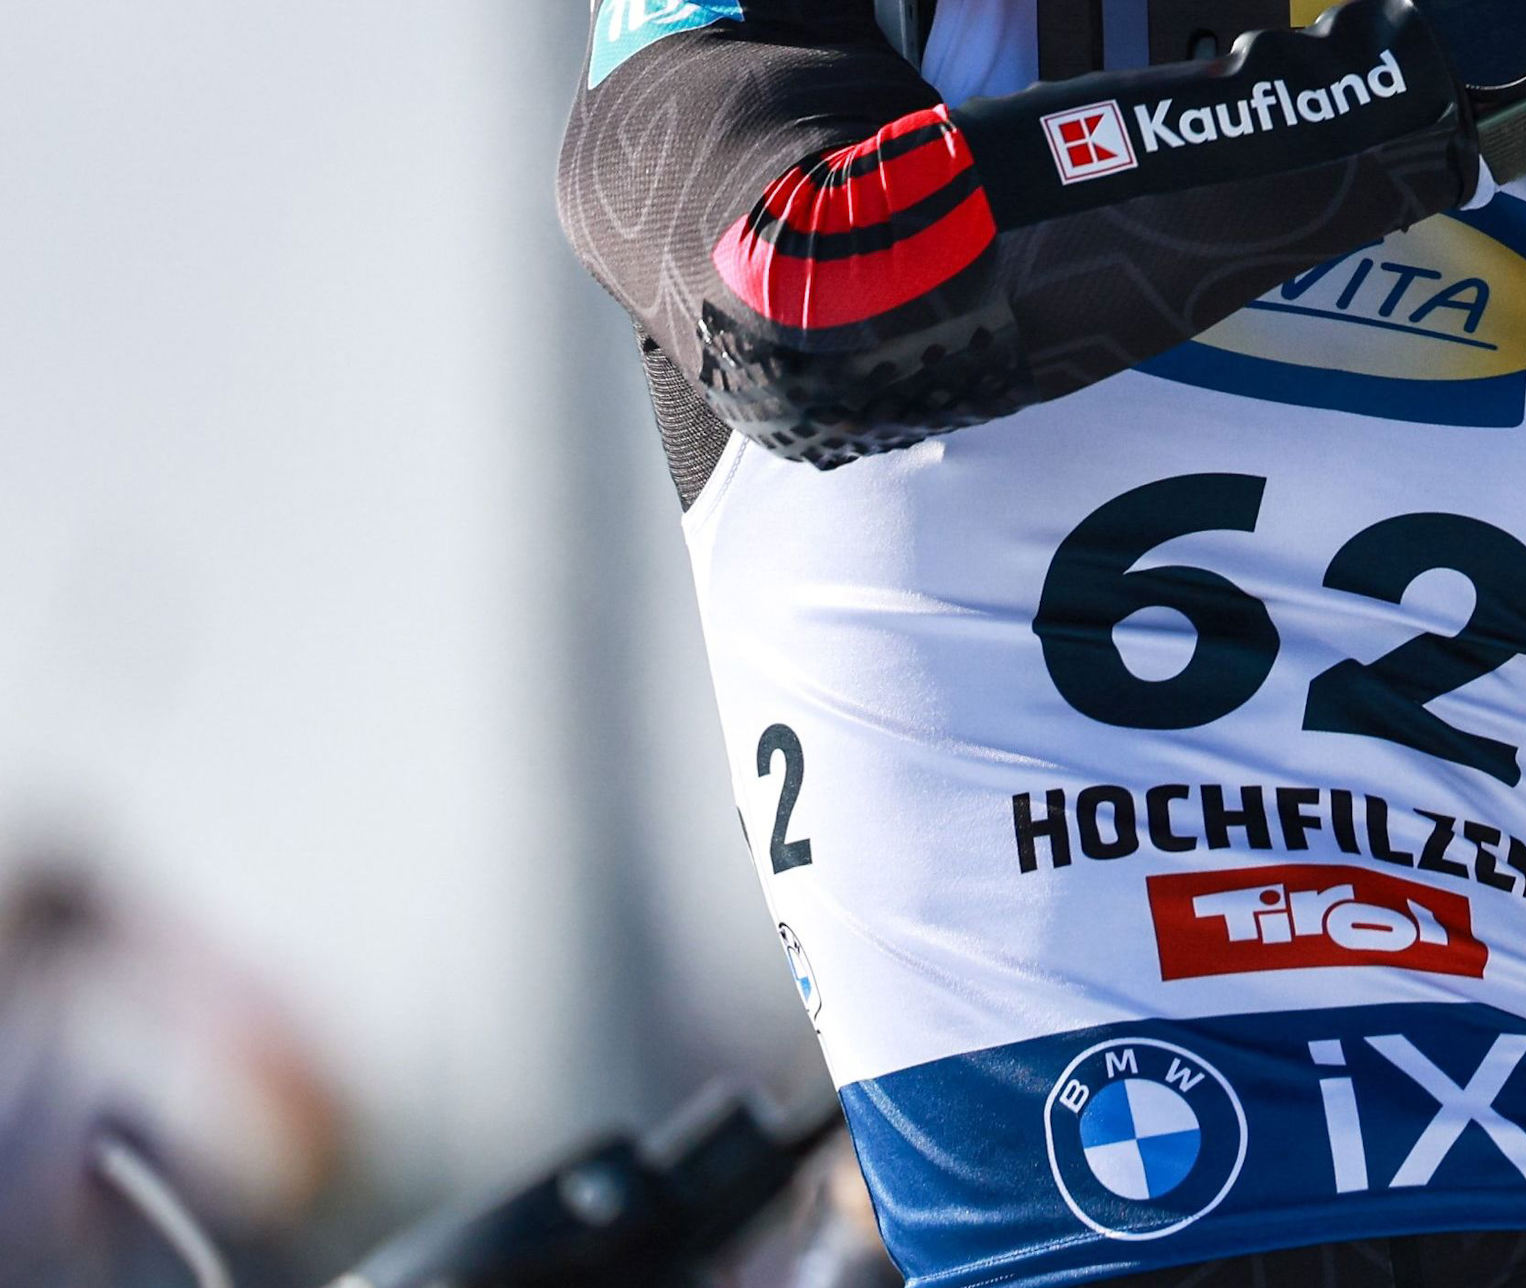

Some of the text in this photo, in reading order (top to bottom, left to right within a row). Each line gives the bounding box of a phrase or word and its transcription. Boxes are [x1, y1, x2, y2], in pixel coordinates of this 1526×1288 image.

[1134, 49, 1407, 153] Kaufland
[738, 723, 813, 874] 2
[1059, 1049, 1205, 1116] BMW
